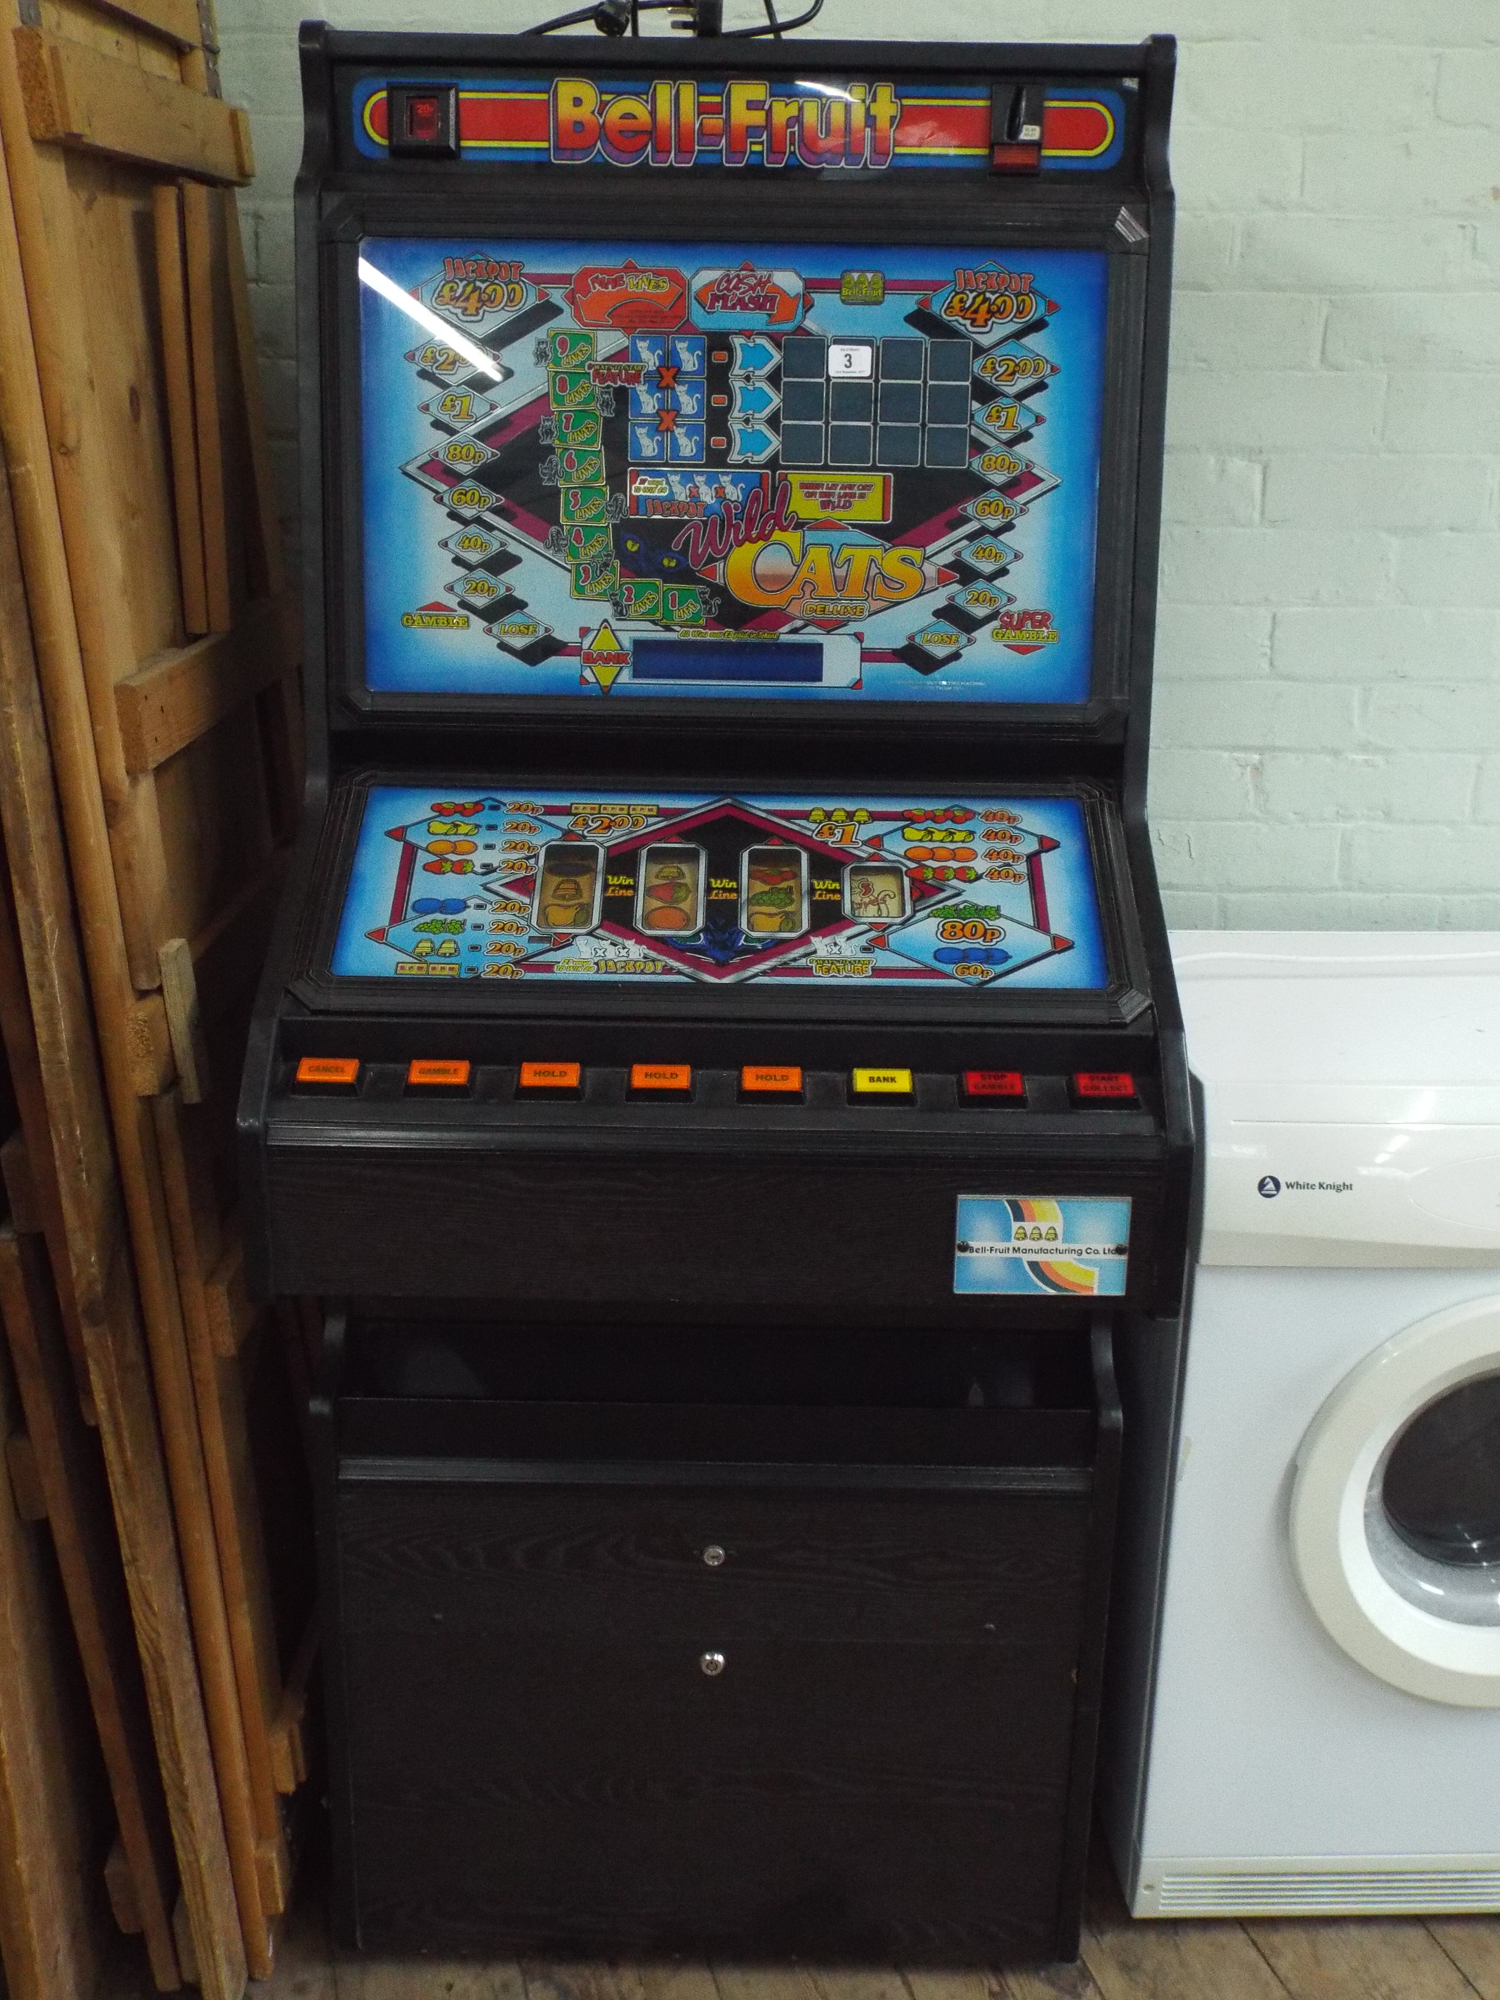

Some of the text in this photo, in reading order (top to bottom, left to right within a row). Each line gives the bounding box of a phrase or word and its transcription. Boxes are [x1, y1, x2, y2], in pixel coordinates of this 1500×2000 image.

[551, 78, 901, 168] Bell-Fruit
[445, 258, 522, 281] JACKPOT
[591, 275, 668, 291] NINE LIVES
[955, 269, 1033, 292] JACKPOT
[707, 293, 779, 313] FLASH
[558, 337, 567, 356] 9
[563, 344, 590, 366] LIVES
[844, 353, 852, 369] 3
[558, 376, 567, 394] 8
[593, 370, 642, 385] FEATURE
[566, 381, 592, 404] LIVES
[440, 395, 473, 421] £1
[563, 414, 573, 431] 7
[986, 404, 1019, 431] £1
[568, 420, 596, 442] LIVES
[445, 444, 484, 465] 80p
[565, 451, 577, 470] 6
[573, 457, 599, 481] LIVES
[981, 454, 1019, 475] 80p
[451, 489, 490, 510] 60p
[570, 491, 579, 509] 5
[820, 500, 853, 512] WILD
[575, 499, 603, 519] LIVES
[646, 499, 707, 518] JACKPOT
[975, 499, 1014, 520] 60p
[672, 478, 798, 570] Wild
[456, 535, 491, 555] 40p
[580, 535, 606, 557] LIVES
[972, 544, 1005, 564] 40p
[581, 566, 590, 583] 3
[725, 530, 925, 608] CATS
[464, 579, 498, 599] 20p
[586, 573, 614, 594] LIVES
[624, 586, 633, 603] 2
[670, 593, 677, 608] 1
[965, 588, 999, 609] 20p
[630, 592, 657, 615] LIVES
[674, 602, 698, 620] LIFE
[804, 602, 866, 618] DELUXE
[402, 614, 469, 629] GAMBLE
[1000, 609, 1053, 631] SUPER
[499, 623, 537, 637] LOSE
[992, 628, 1058, 643] GAMBLE
[921, 632, 960, 646] LOSE
[582, 651, 631, 666] BANK
[507, 803, 543, 816] 20p
[981, 809, 1021, 825] 40p
[503, 821, 540, 834] 20p
[816, 822, 860, 847] £1
[982, 828, 1022, 844] 40p
[500, 840, 539, 854] 20p
[984, 848, 1024, 863] 40p
[500, 860, 537, 874] 20p
[984, 867, 1025, 883] 40p
[606, 875, 635, 886] Win
[709, 879, 738, 889] Win
[812, 879, 841, 890] Win
[605, 886, 635, 897] Line
[709, 890, 738, 900] Line
[813, 891, 841, 901] Line
[491, 901, 530, 915] 20p
[489, 921, 528, 935] 20p
[941, 921, 1002, 943] 80p
[487, 942, 526, 957] 20p
[484, 963, 523, 978] 20p
[597, 959, 665, 974] JACKPOT
[815, 963, 869, 976] FEATURE
[954, 965, 993, 979] 60p
[307, 1065, 345, 1074] CANCEL
[418, 1067, 459, 1076] GAMBLE
[533, 1069, 567, 1078] HOLD
[644, 1071, 678, 1080] HOLD
[755, 1074, 789, 1082] HOLD
[868, 1076, 897, 1084] BANK
[980, 1074, 1007, 1082] STOP
[1088, 1075, 1119, 1083] START
[1285, 1181, 1354, 1194] White Knight
[968, 1246, 1010, 1255] Bell-Fruit
[1012, 1246, 1083, 1257] Manufacturing
[1085, 1247, 1101, 1256] Co.
